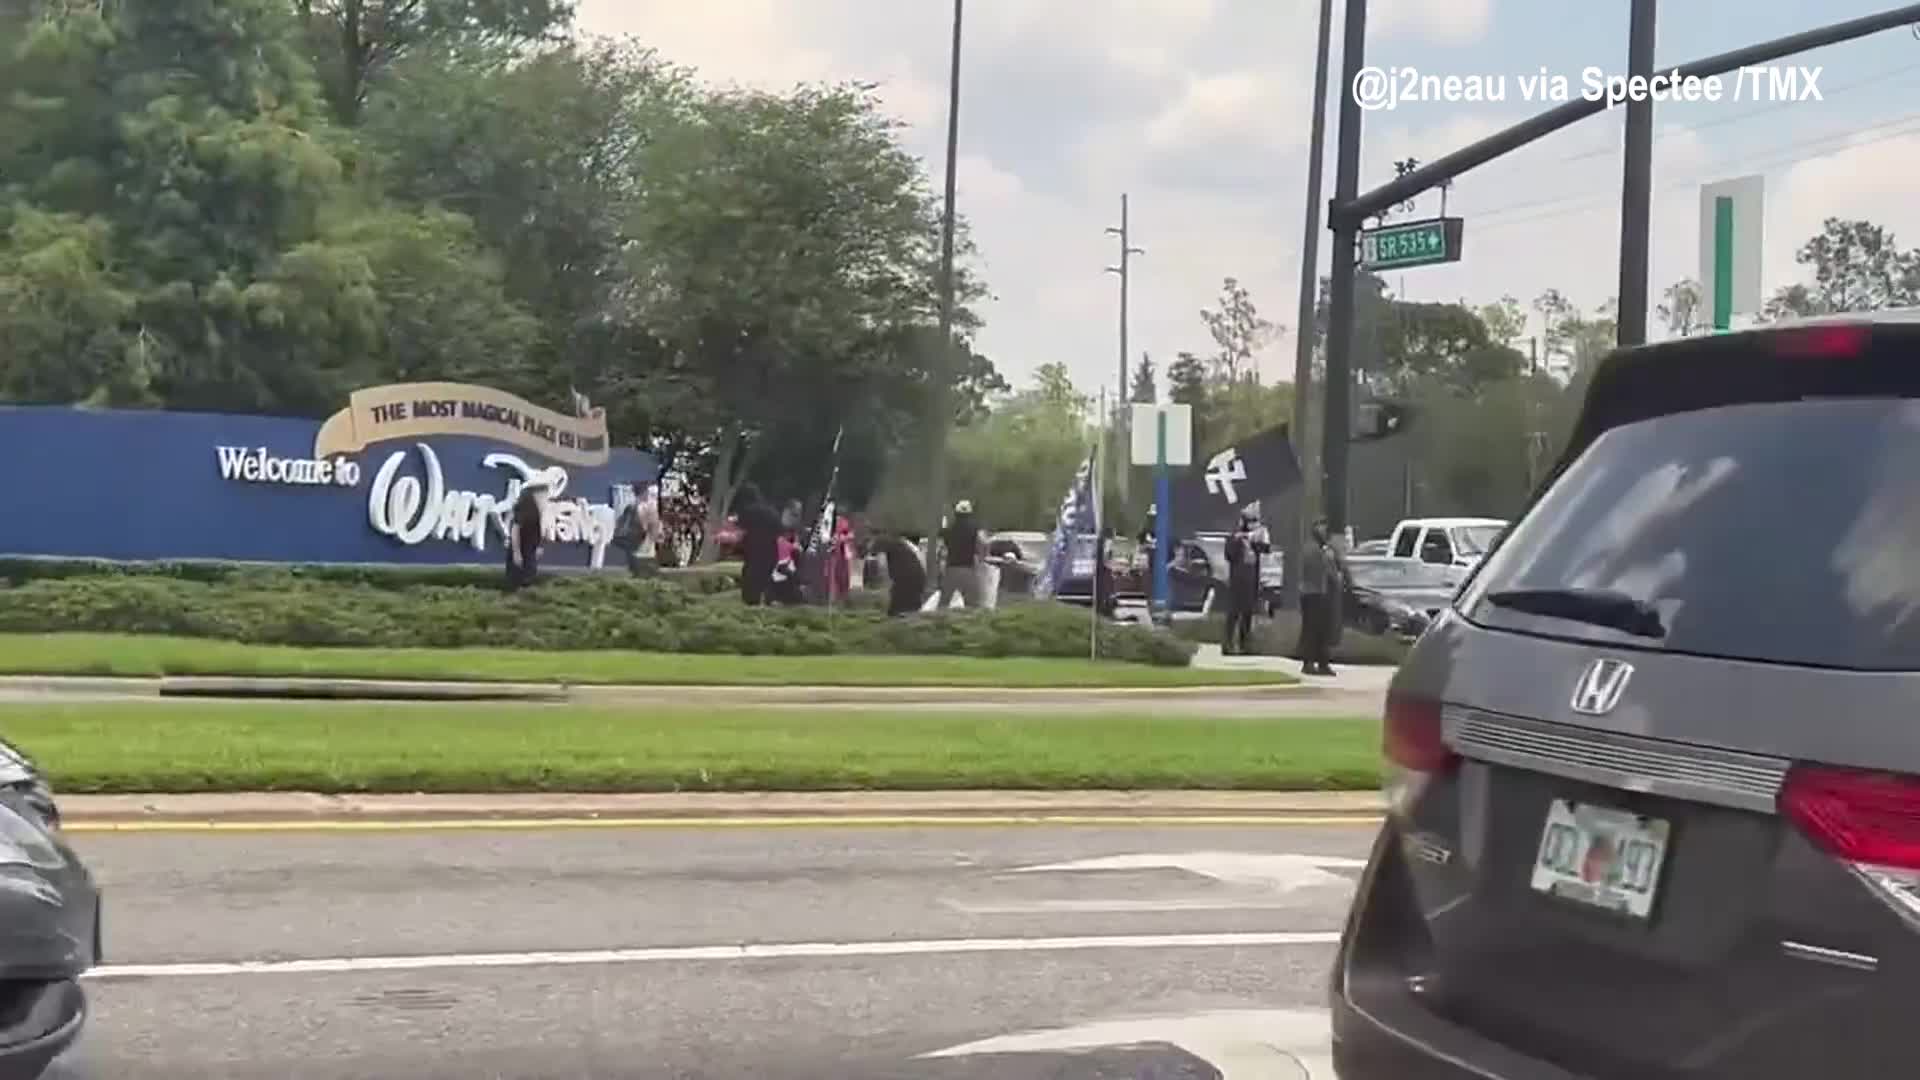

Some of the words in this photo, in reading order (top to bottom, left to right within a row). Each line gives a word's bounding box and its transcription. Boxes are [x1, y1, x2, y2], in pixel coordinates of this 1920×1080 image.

[1399, 231, 1426, 254] 535
[371, 402, 407, 424] THE
[412, 400, 457, 418] MOST
[462, 401, 521, 429] MAGICAL
[216, 446, 333, 484] Welcome
[334, 456, 361, 486] to
